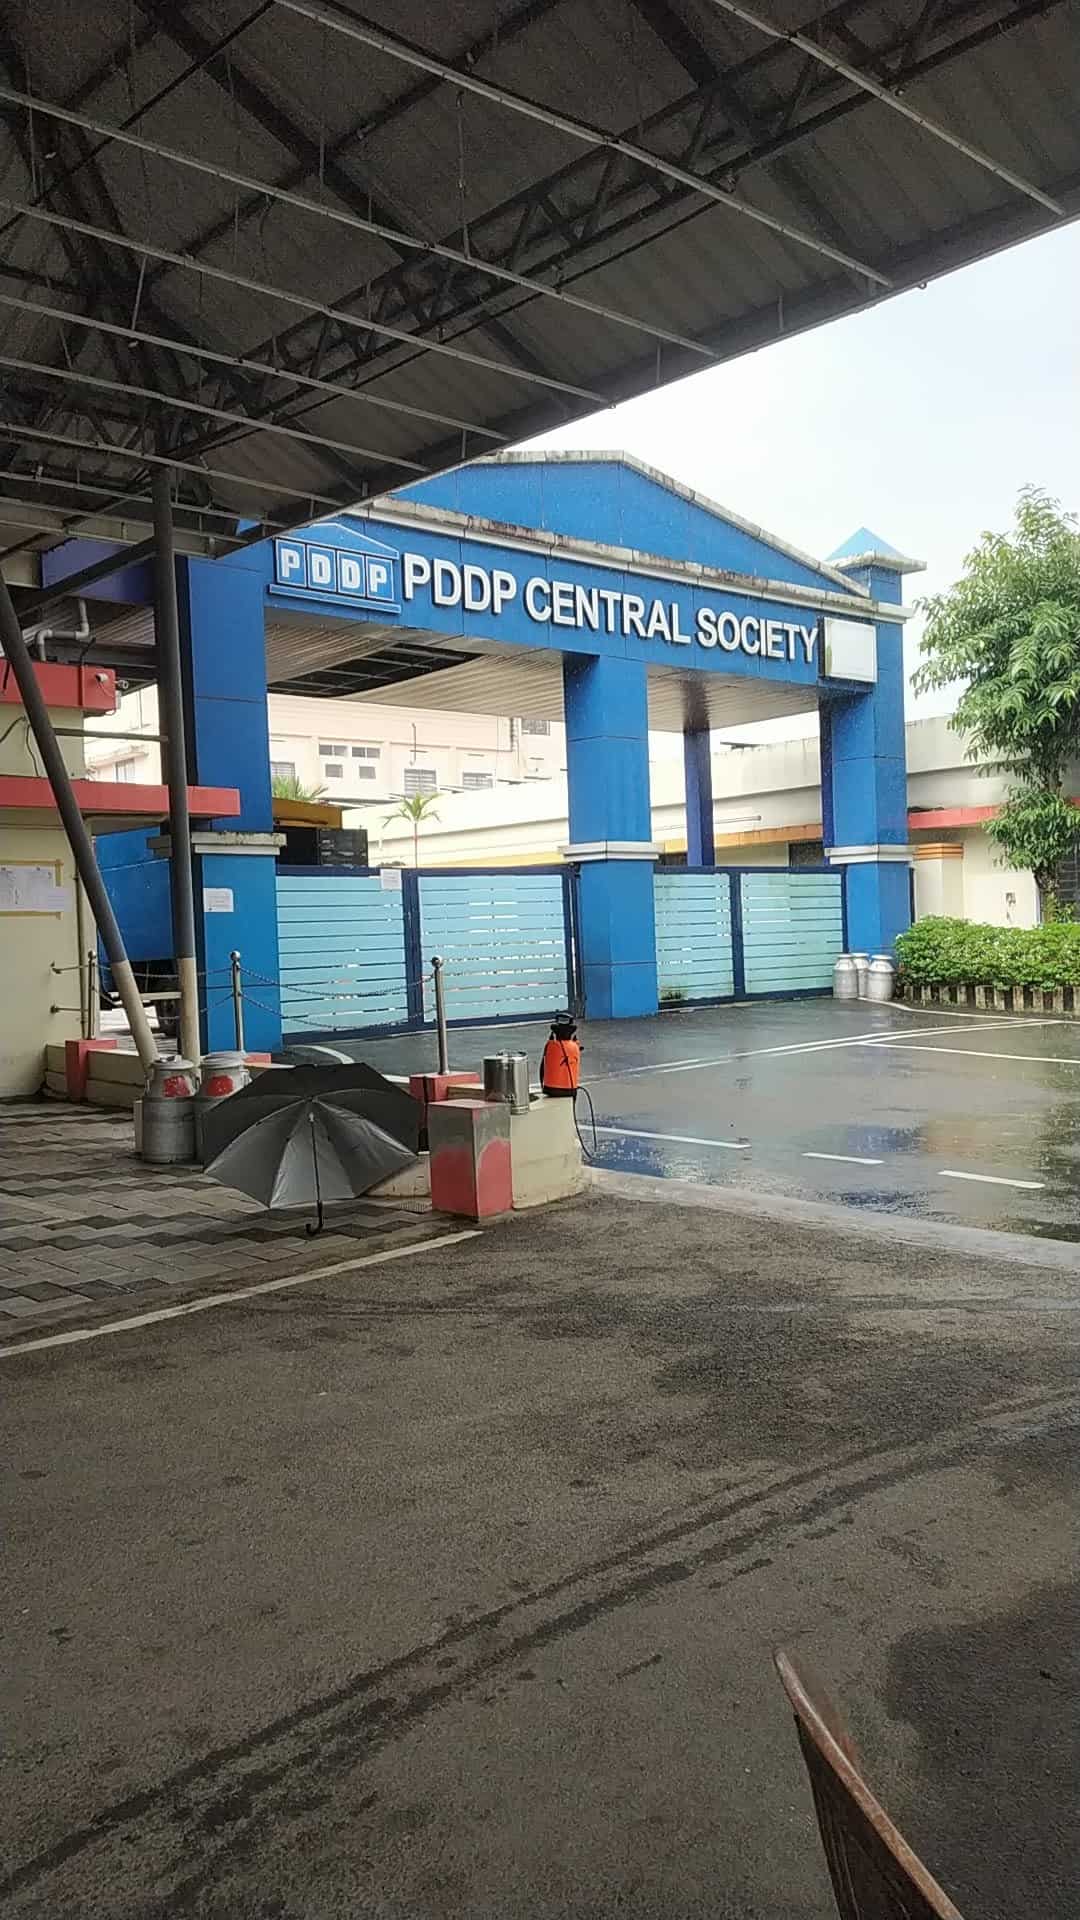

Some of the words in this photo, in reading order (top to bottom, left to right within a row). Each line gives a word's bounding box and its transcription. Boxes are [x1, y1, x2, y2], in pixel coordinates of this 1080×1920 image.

[279, 547, 388, 593] PDDP
[404, 552, 517, 614] PDDP
[524, 577, 692, 645] CENTRAL
[697, 607, 819, 663] SOCIETY
